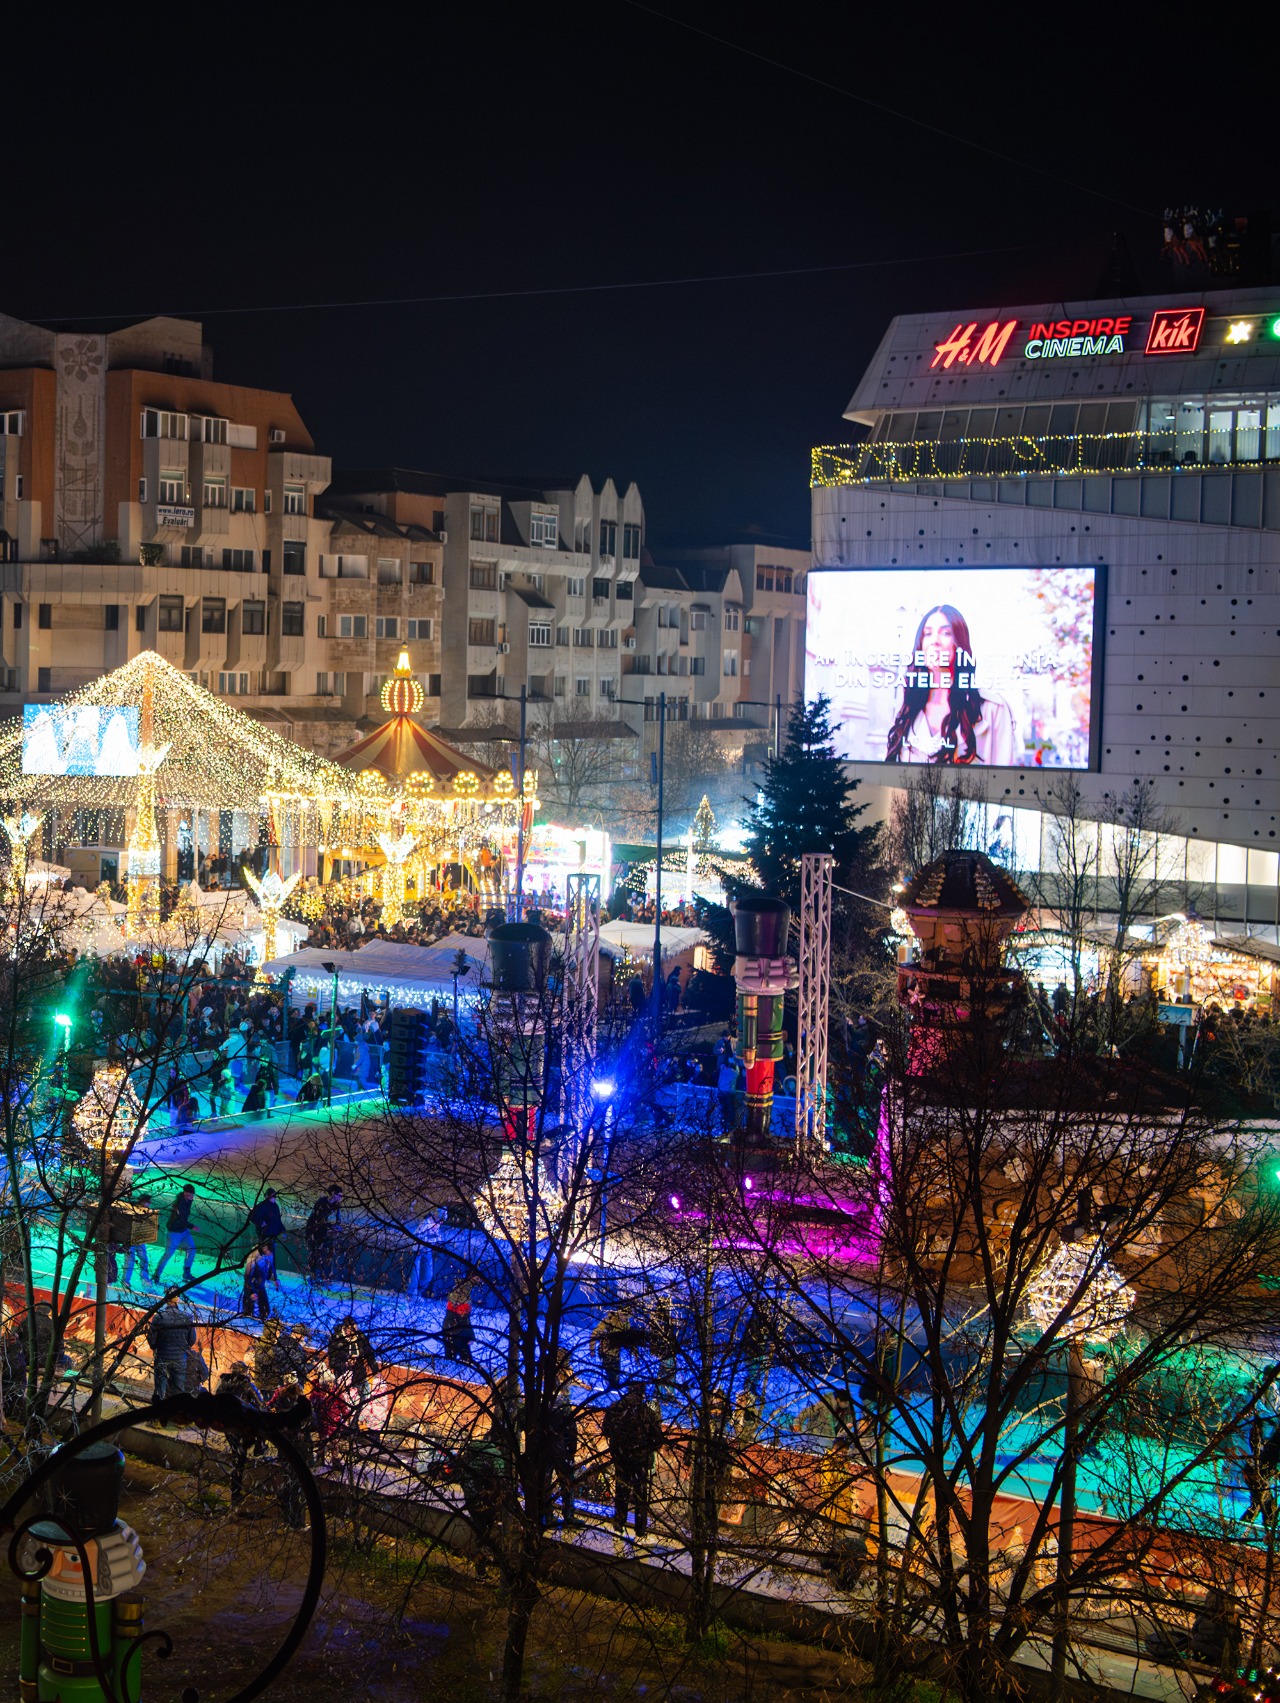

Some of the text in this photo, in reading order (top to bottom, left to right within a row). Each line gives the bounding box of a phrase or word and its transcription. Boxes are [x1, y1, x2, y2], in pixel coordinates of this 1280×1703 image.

[1028, 316, 1133, 341] INSPIRE
[930, 320, 1018, 369] H&M
[1024, 334, 1124, 359] CINEMA
[814, 652, 838, 667] AM
[955, 647, 977, 667] ÎN
[834, 671, 1032, 690] DIN SPATELE ELSEE
[902, 734, 955, 749] L'OAL
